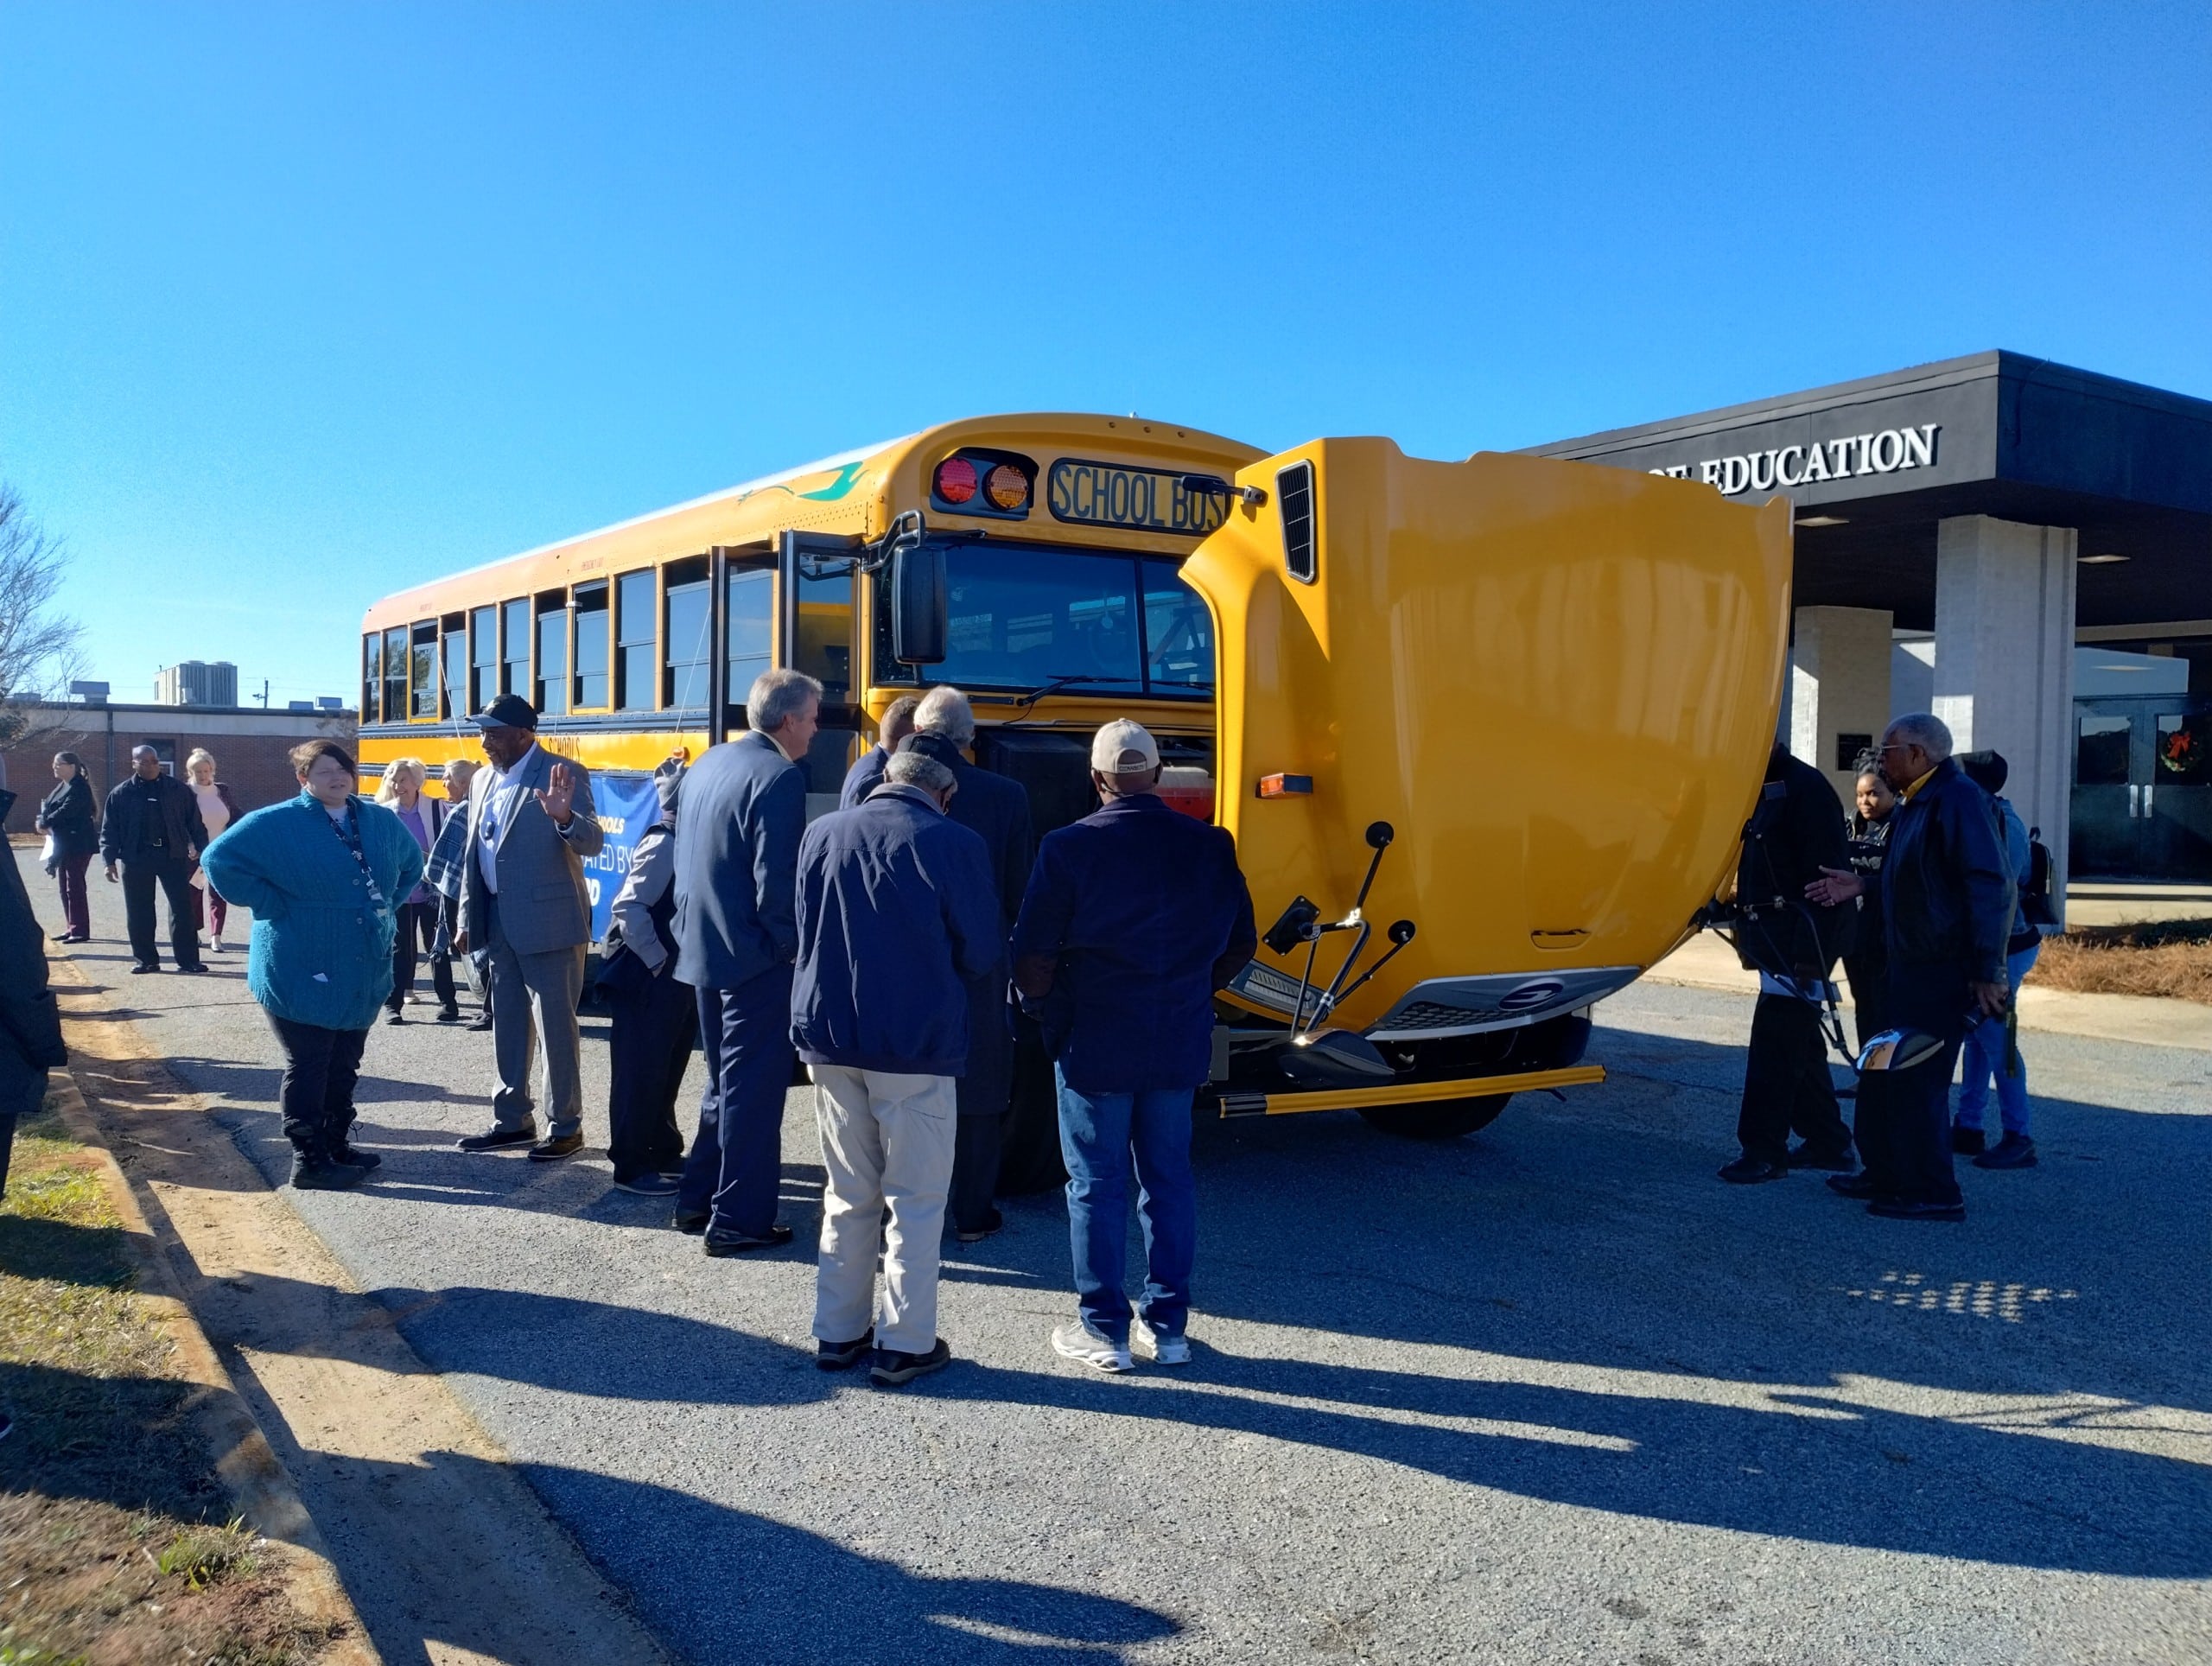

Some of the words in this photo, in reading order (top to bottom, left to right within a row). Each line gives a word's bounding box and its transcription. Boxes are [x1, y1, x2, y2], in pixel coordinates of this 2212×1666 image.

[1700, 423, 1937, 495] EDUCATION
[1052, 464, 1165, 526] SCHOOL
[1171, 479, 1223, 532] BUS
[617, 846, 634, 874] BY
